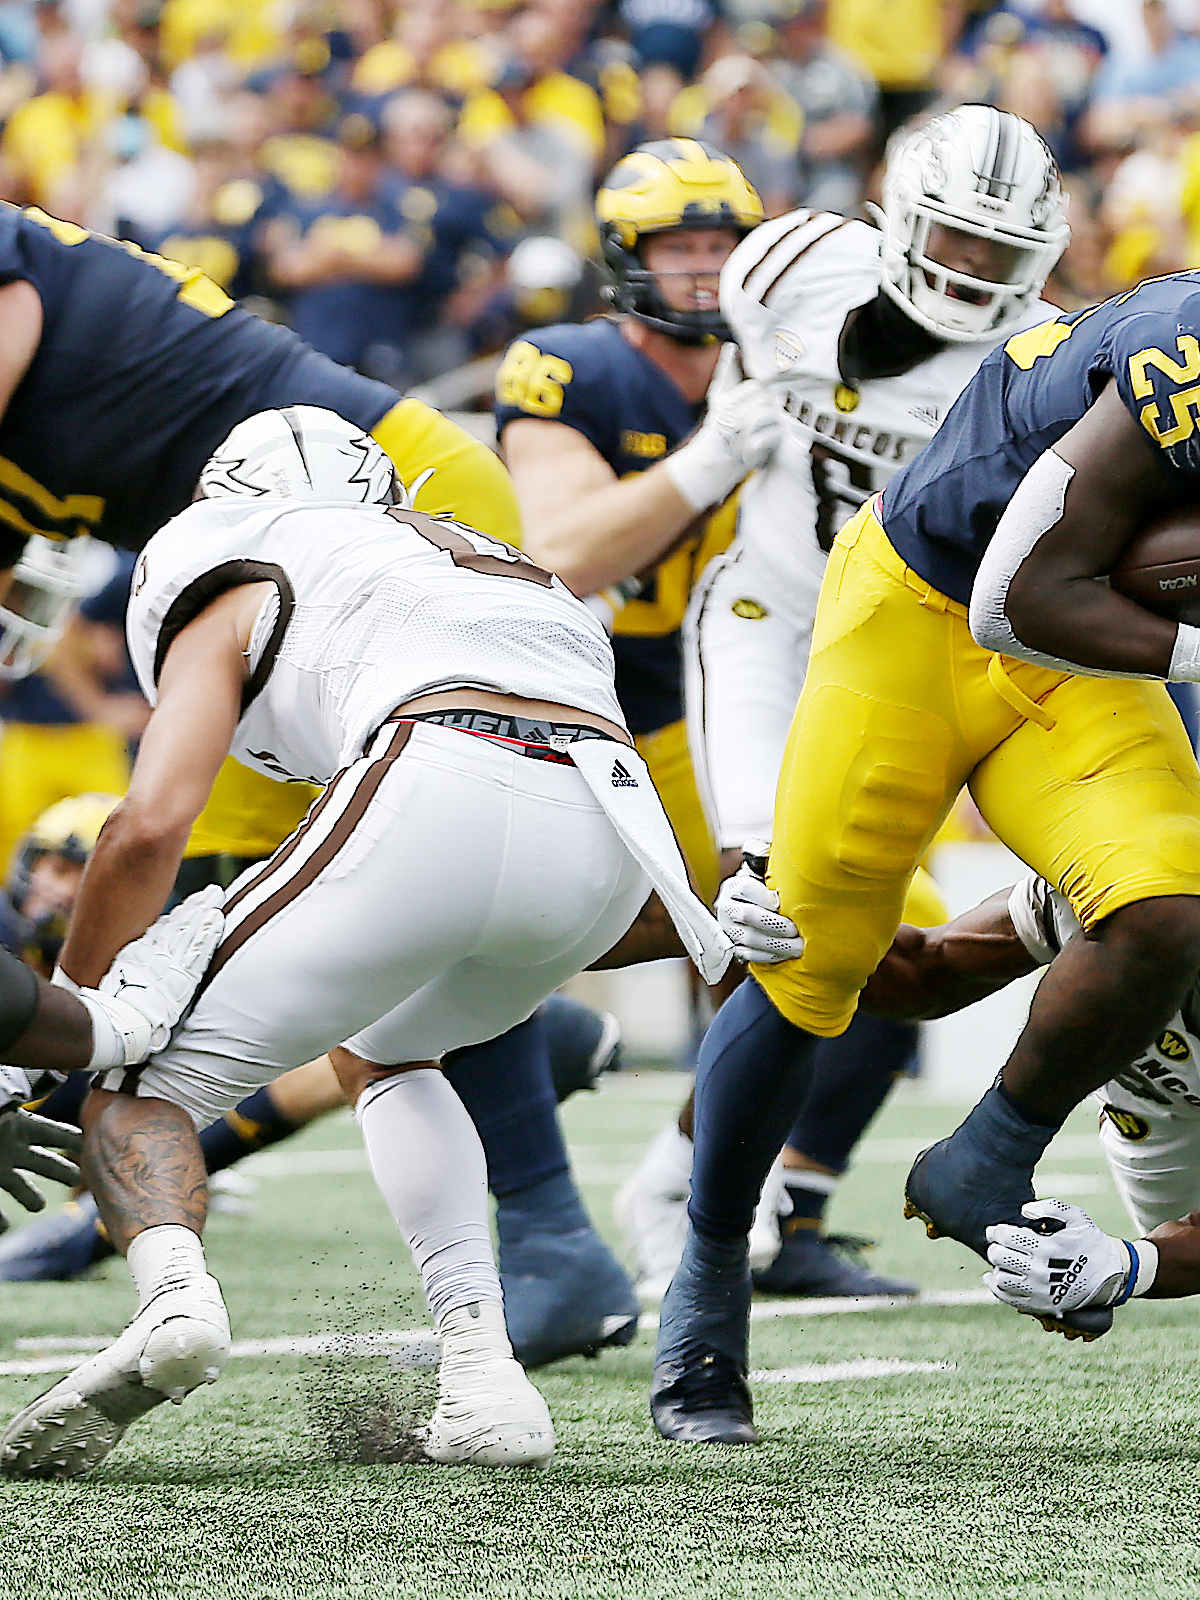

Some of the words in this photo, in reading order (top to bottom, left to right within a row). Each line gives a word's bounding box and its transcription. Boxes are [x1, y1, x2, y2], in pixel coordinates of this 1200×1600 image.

[1159, 575, 1198, 590] NCAA
[1159, 1031, 1188, 1058] W
[1053, 1254, 1088, 1305] adidas
